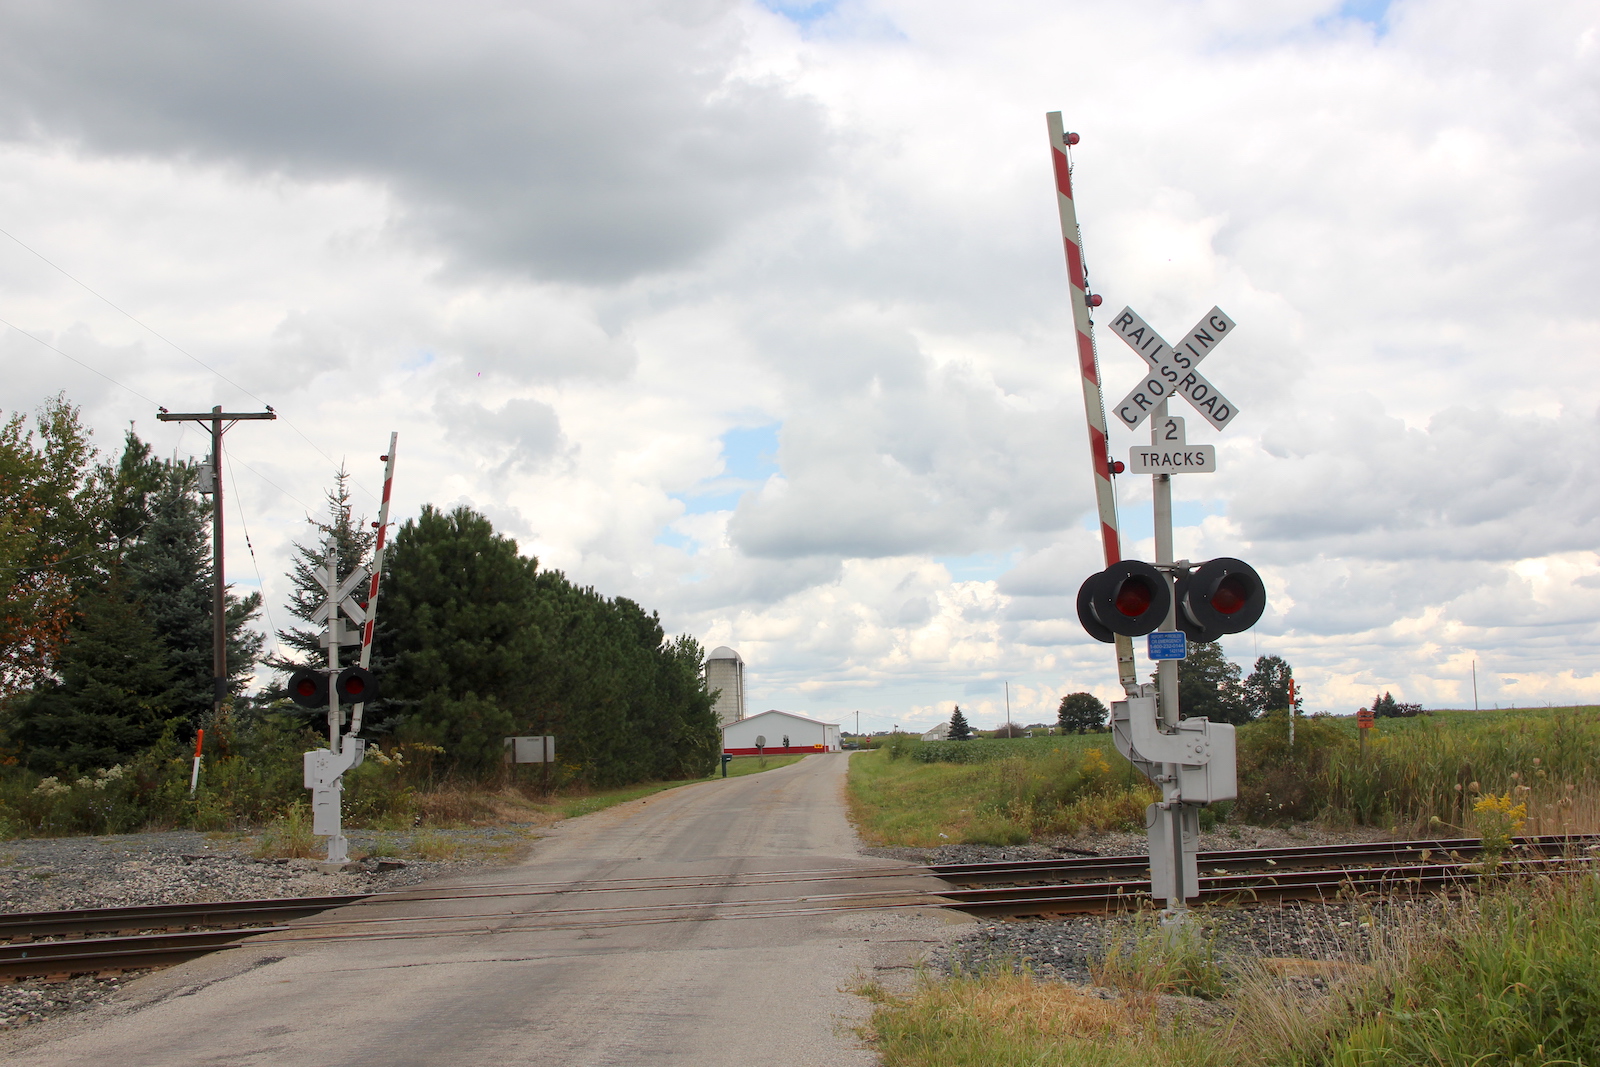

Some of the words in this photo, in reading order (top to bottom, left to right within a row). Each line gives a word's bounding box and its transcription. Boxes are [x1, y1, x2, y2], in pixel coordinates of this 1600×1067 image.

[1115, 311, 1163, 364] RAIL
[1178, 372, 1230, 422] ROAD
[1120, 315, 1227, 423] CROSSING
[1140, 452, 1205, 467] TRACKS
[1165, 421, 1178, 440] 2
